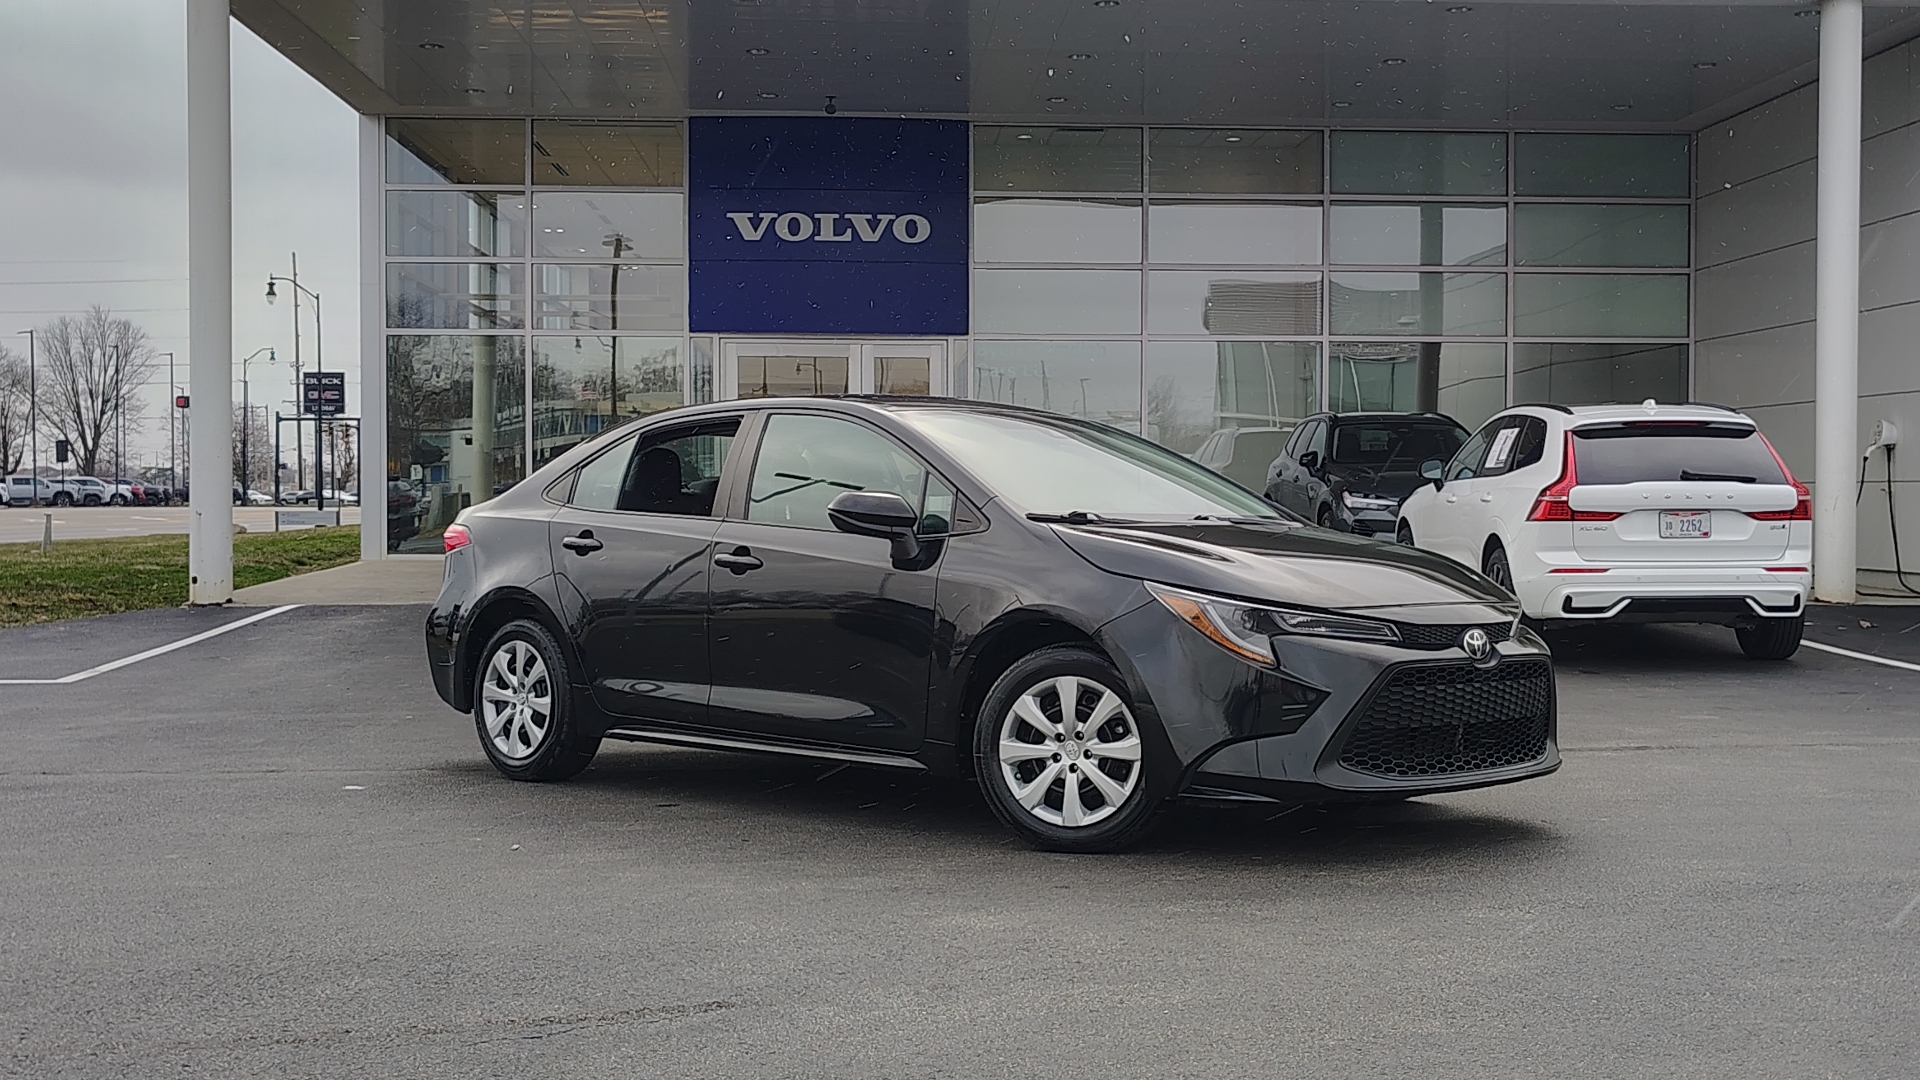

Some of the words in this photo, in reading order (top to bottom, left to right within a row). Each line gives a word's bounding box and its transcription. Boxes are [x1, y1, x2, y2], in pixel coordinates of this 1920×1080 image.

[726, 212, 931, 244] VOLVO
[305, 377, 342, 385] BUICK
[1642, 492, 1735, 500] VOLVO
